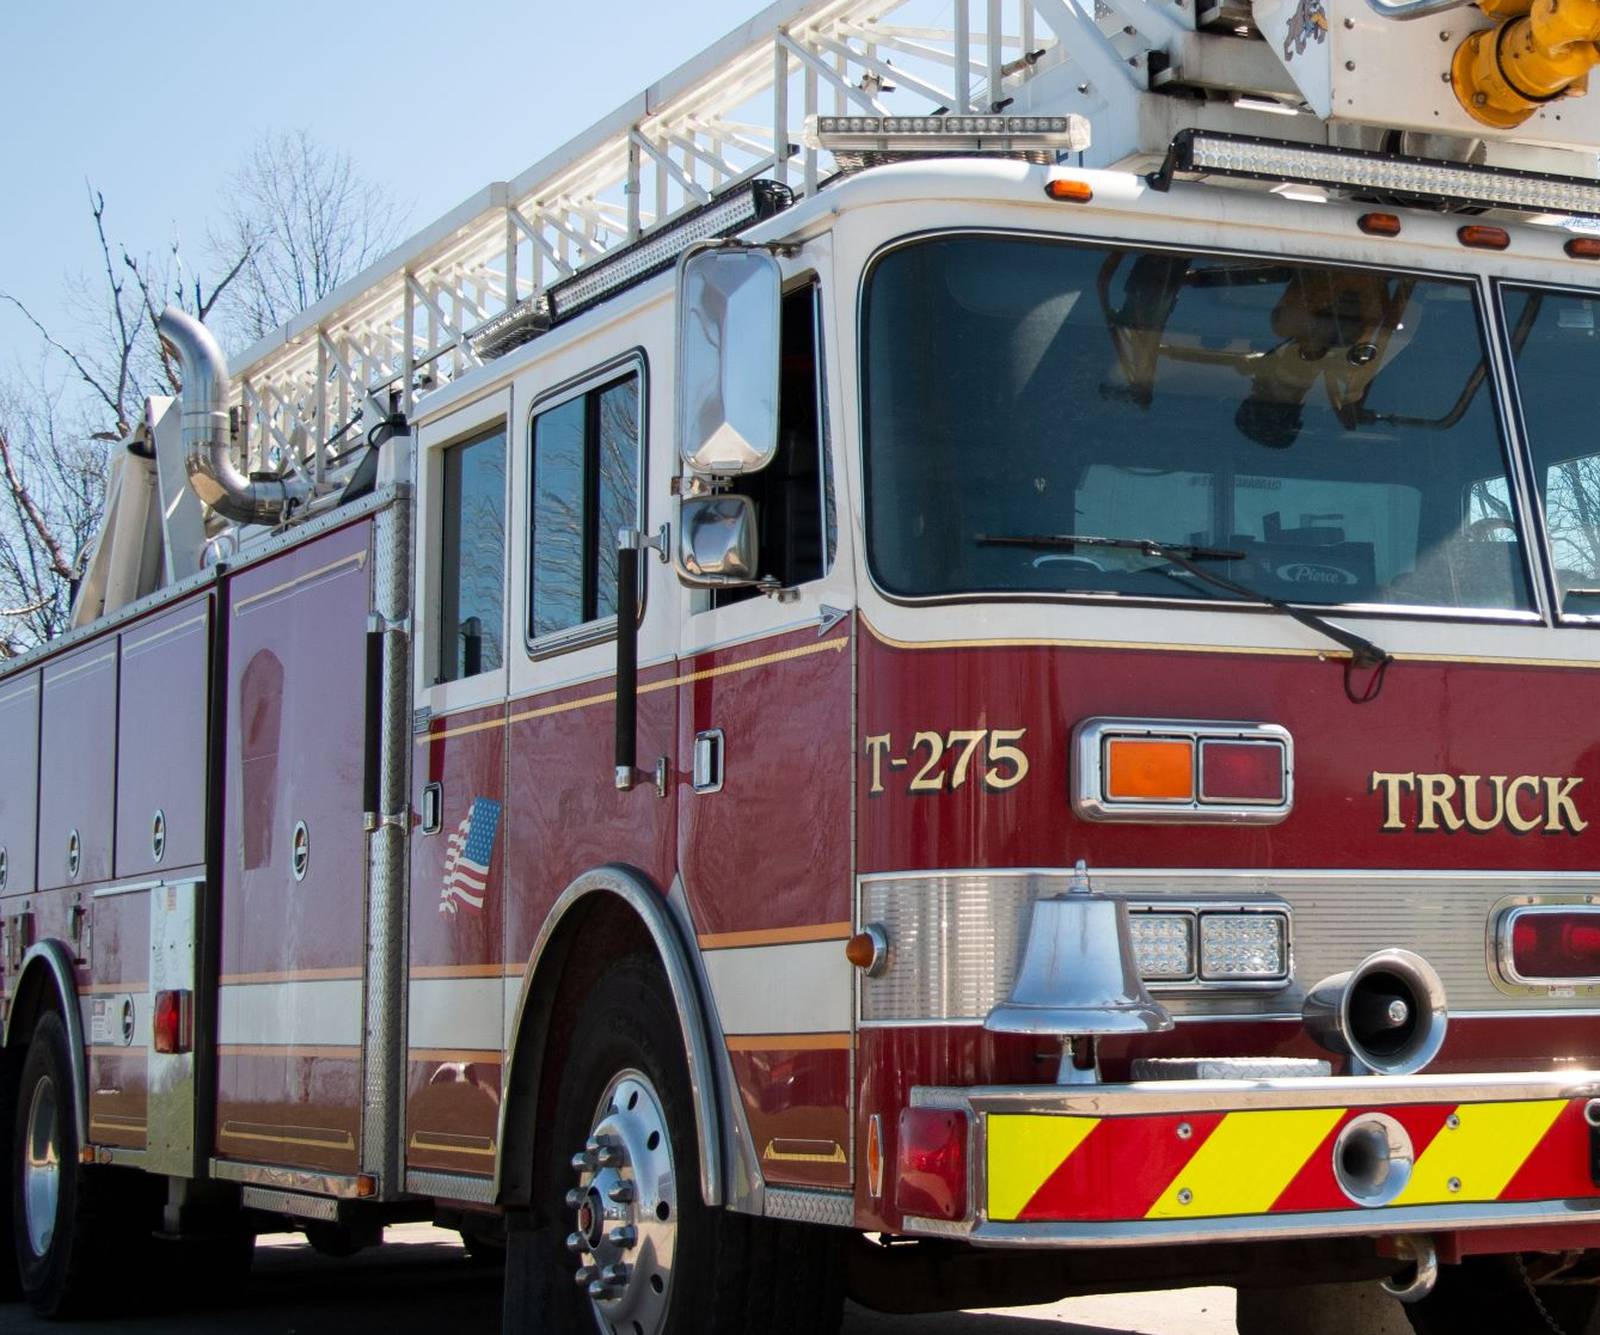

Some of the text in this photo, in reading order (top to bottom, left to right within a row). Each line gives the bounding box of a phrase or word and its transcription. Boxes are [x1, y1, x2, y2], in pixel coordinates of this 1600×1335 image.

[1294, 565, 1339, 584] Pierce
[865, 728, 1030, 793] T-275
[1370, 770, 1589, 833] TRUCK
